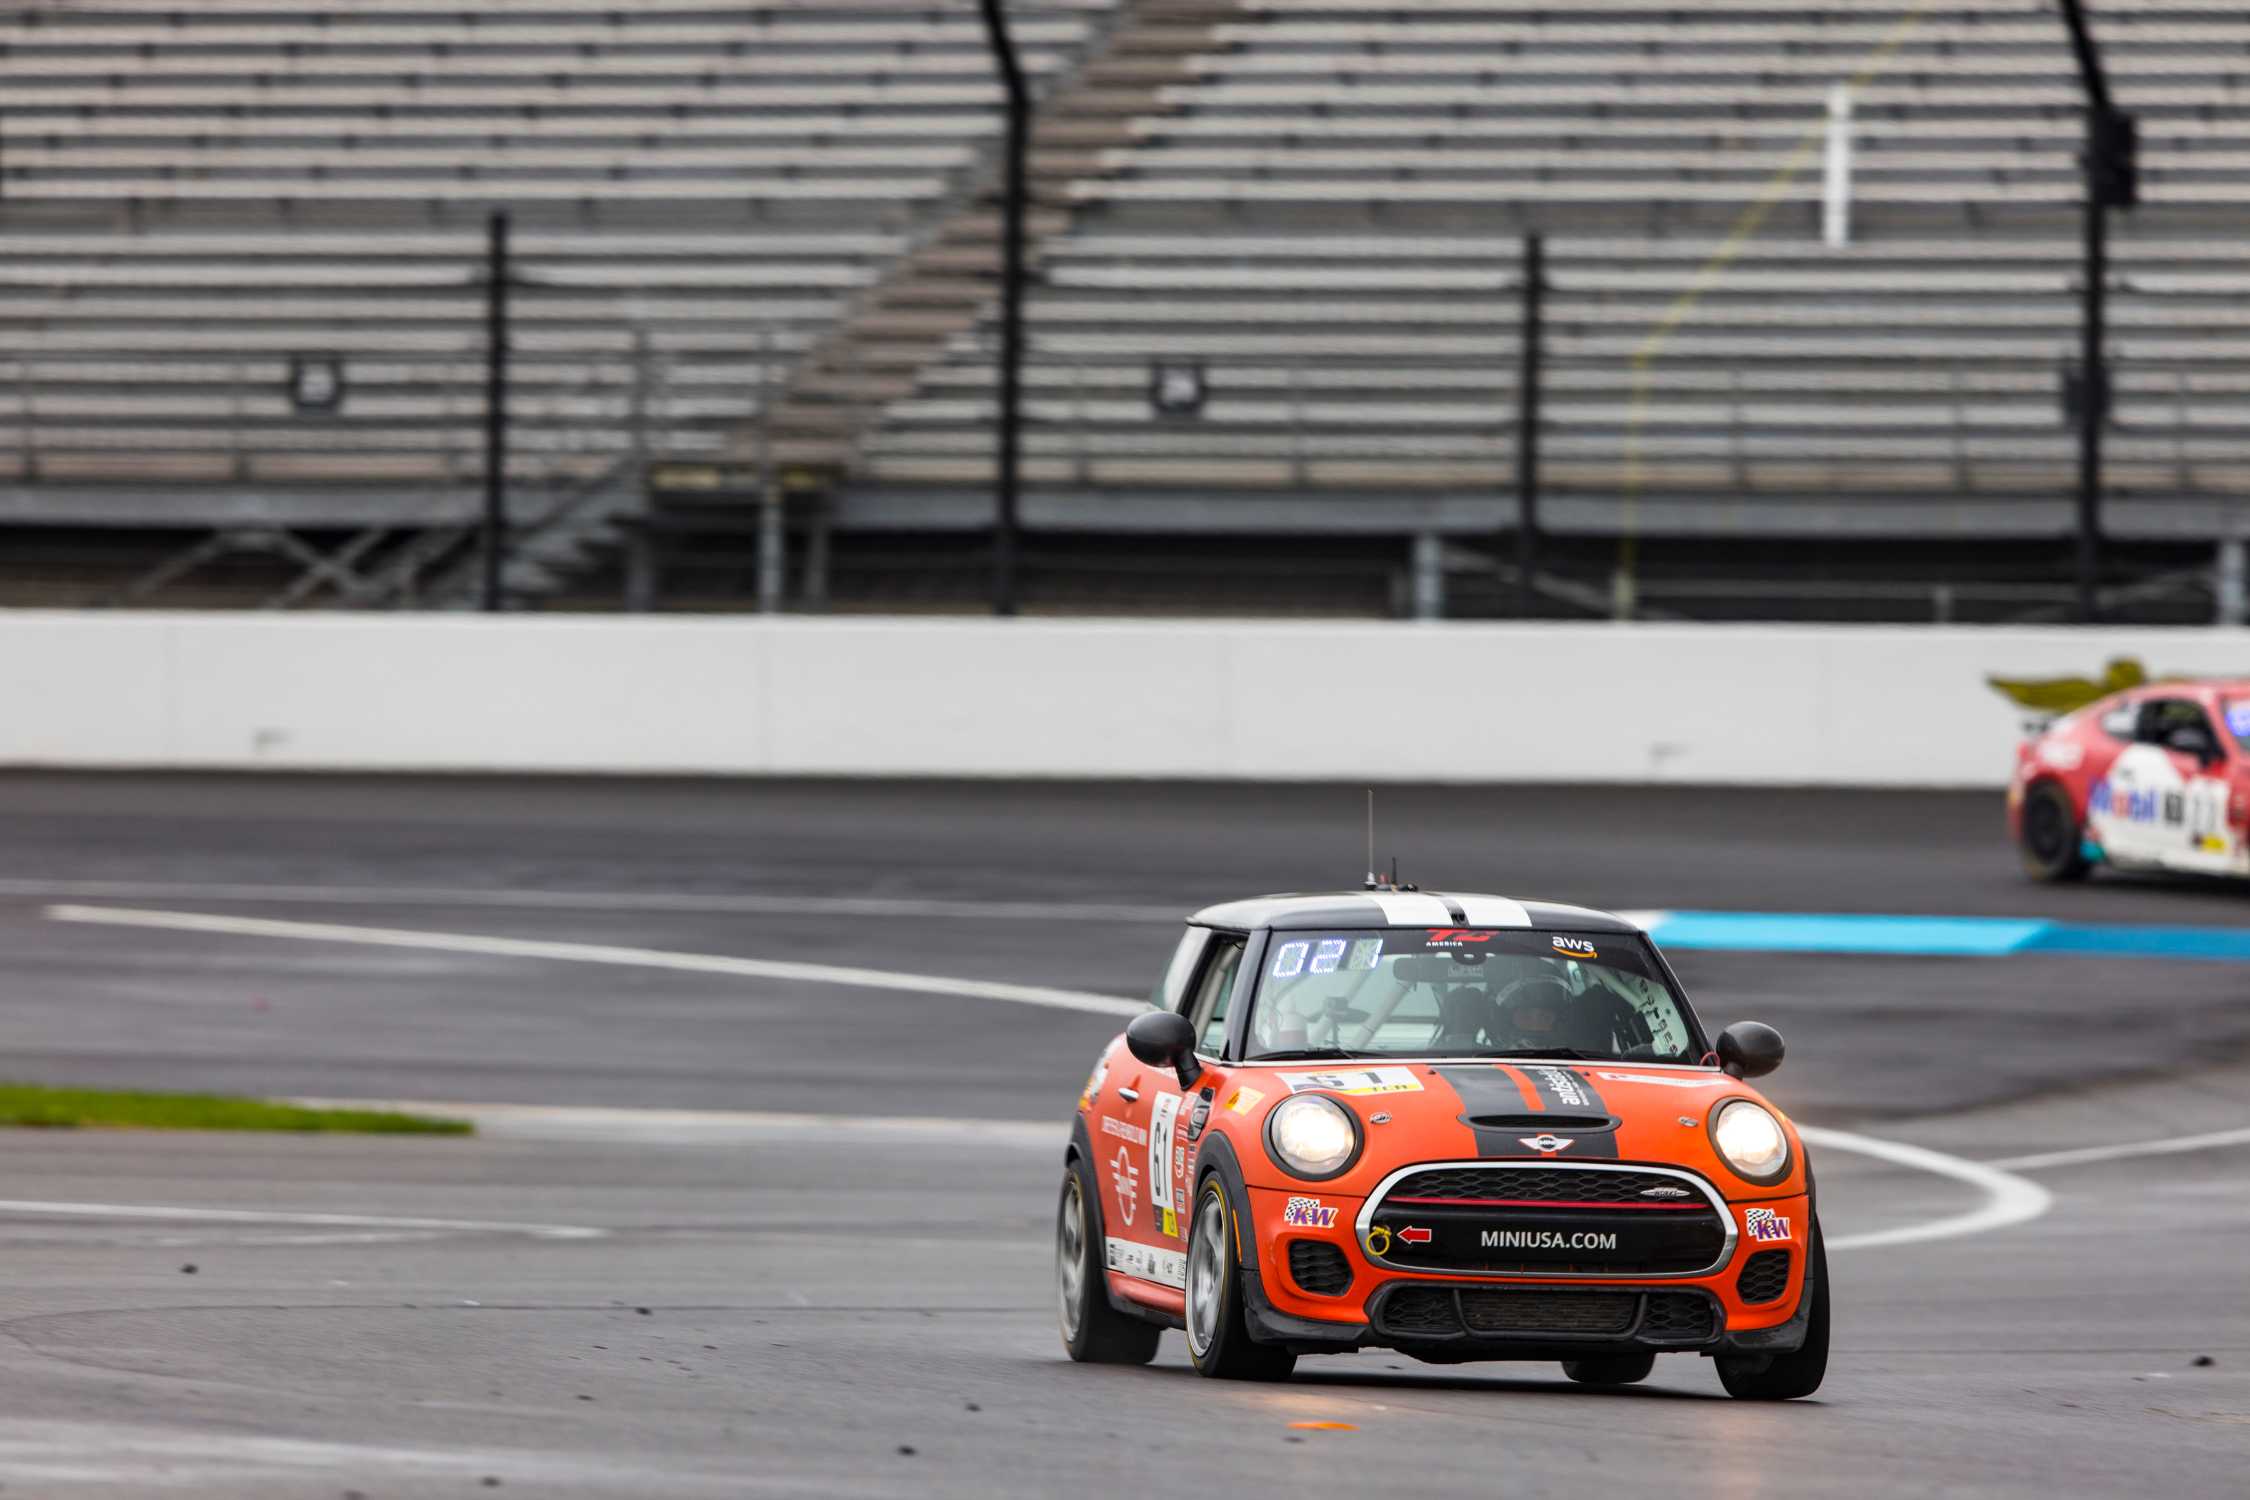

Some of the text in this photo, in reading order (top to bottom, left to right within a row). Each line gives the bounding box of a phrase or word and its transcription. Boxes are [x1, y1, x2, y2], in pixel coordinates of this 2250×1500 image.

[1552, 935, 1595, 952] aws
[1153, 1121, 1169, 1202] 61
[1292, 1206, 1336, 1226] KW
[1756, 1218, 1789, 1240] KW
[1480, 1230, 1617, 1250] MINIUSA.COM
